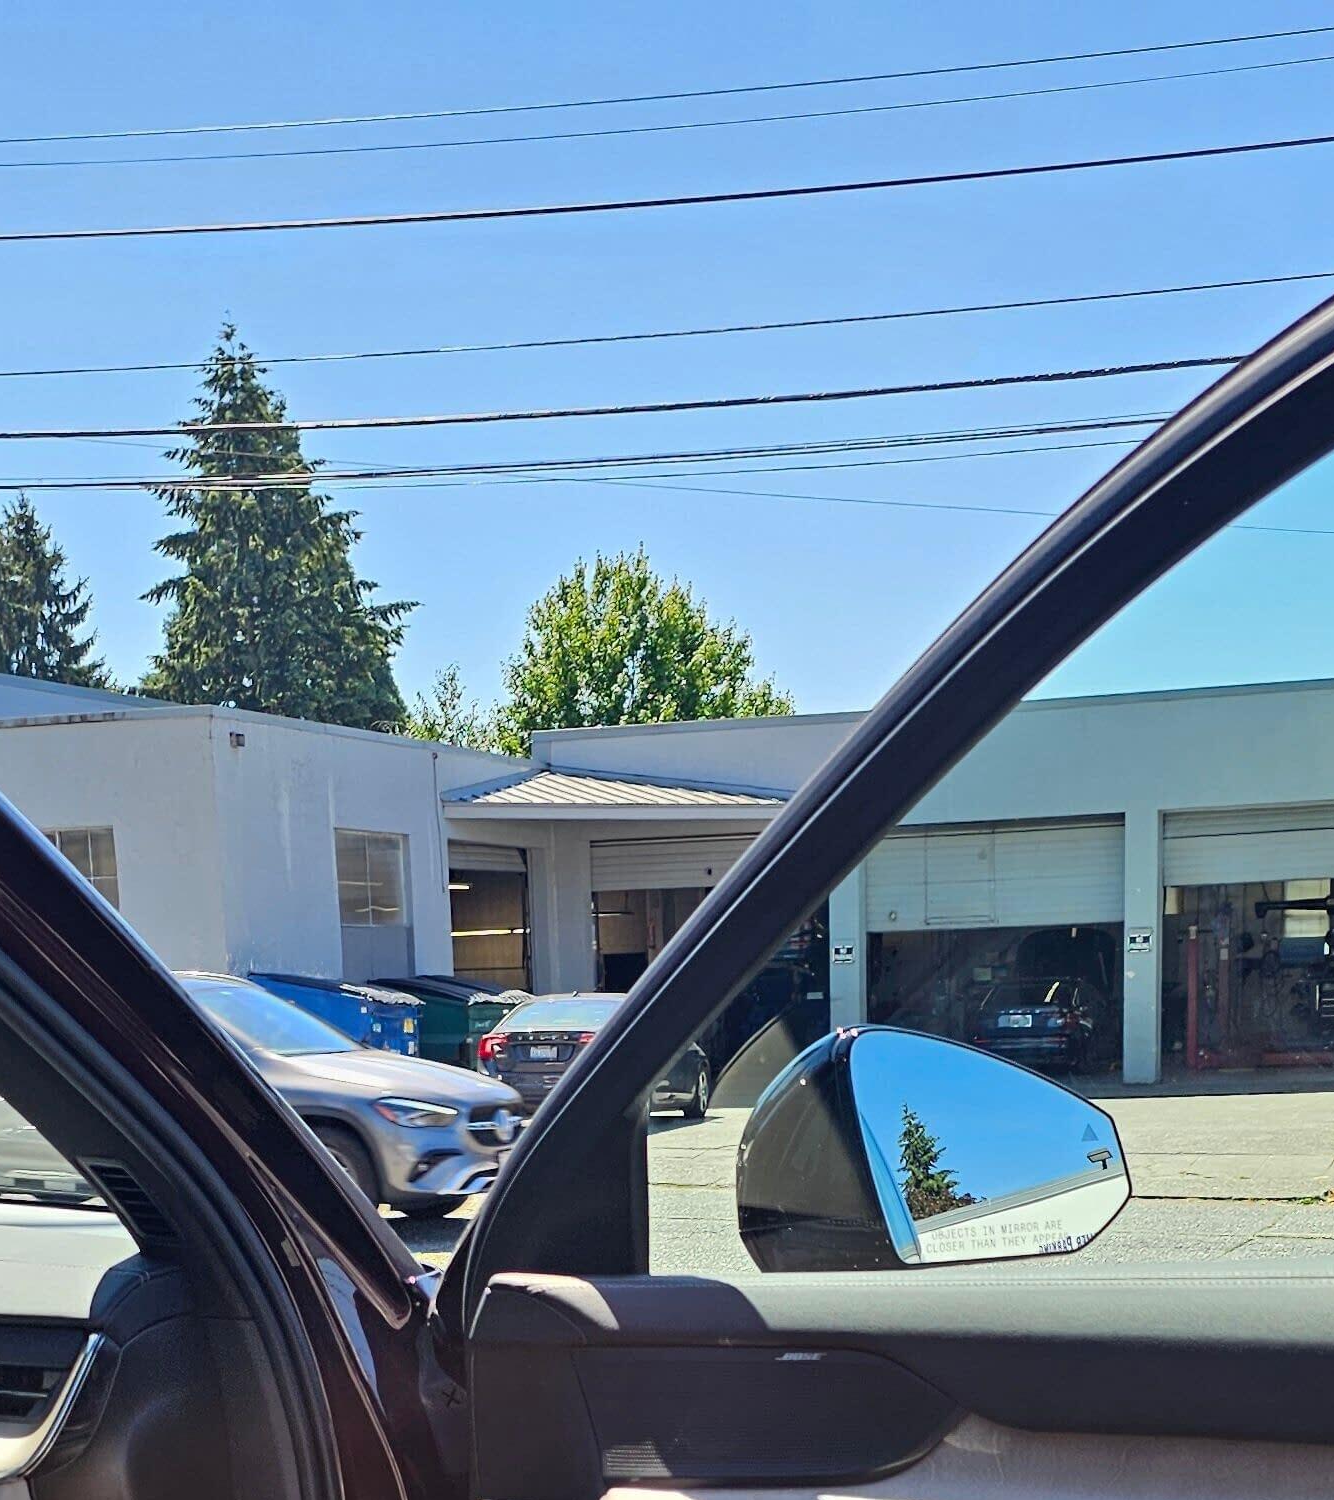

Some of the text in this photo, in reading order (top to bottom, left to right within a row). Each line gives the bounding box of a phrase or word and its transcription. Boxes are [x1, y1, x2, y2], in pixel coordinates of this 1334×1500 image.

[931, 1219, 1063, 1240] OBJECTS IN MIRROR ARE
[926, 1241, 965, 1253] CLOSER
[971, 1239, 996, 1249] THAN
[1002, 1235, 1027, 1247] THEY
